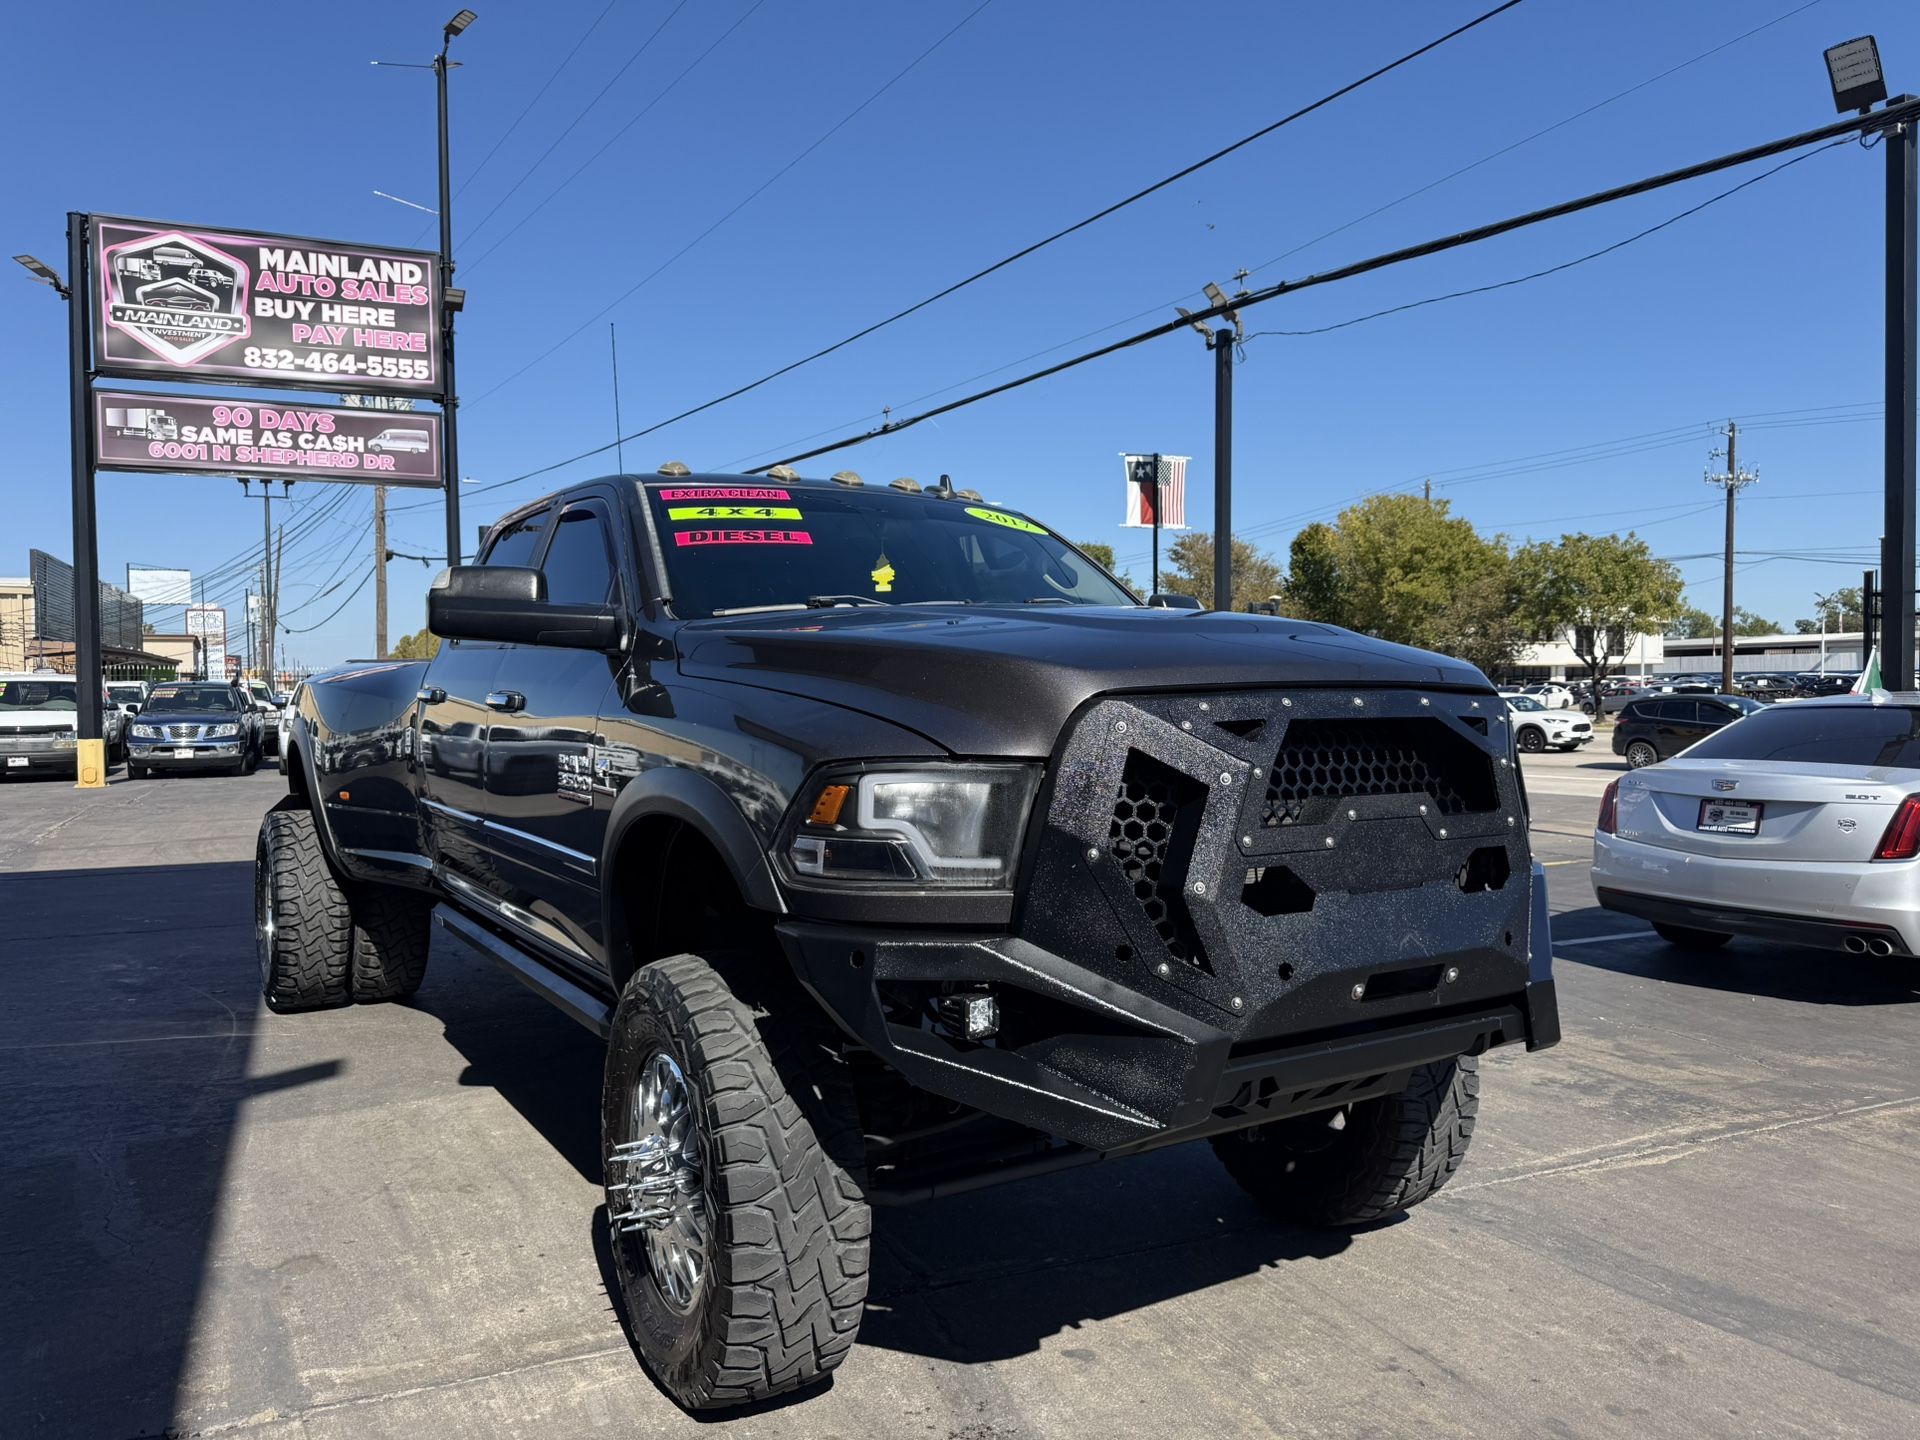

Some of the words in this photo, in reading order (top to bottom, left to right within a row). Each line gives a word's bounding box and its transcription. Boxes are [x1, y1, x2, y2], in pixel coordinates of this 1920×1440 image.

[258, 247, 423, 285] MAINLAND
[255, 270, 336, 297] AUTO
[341, 279, 428, 305] SALES
[123, 310, 232, 330] MAINLAND
[254, 297, 316, 320] BUY
[321, 303, 395, 327] HERE
[152, 328, 207, 338] INVESTMENT
[292, 323, 348, 345] PAY
[354, 328, 427, 352] HERE
[244, 347, 429, 379] 832-464-5555
[212, 406, 253, 428] 90
[259, 409, 336, 434] DAYS
[181, 427, 253, 445] SAME
[258, 431, 293, 448] AS
[298, 434, 365, 453] CA$H
[149, 441, 208, 461] 6001
[212, 444, 231, 461] N
[235, 445, 359, 468] SHEPHERD
[364, 453, 395, 471] DR
[671, 489, 723, 498] EXTRA
[729, 490, 780, 498] CLEAN
[980, 511, 1029, 529] 2017
[689, 531, 799, 543] DIESEL
